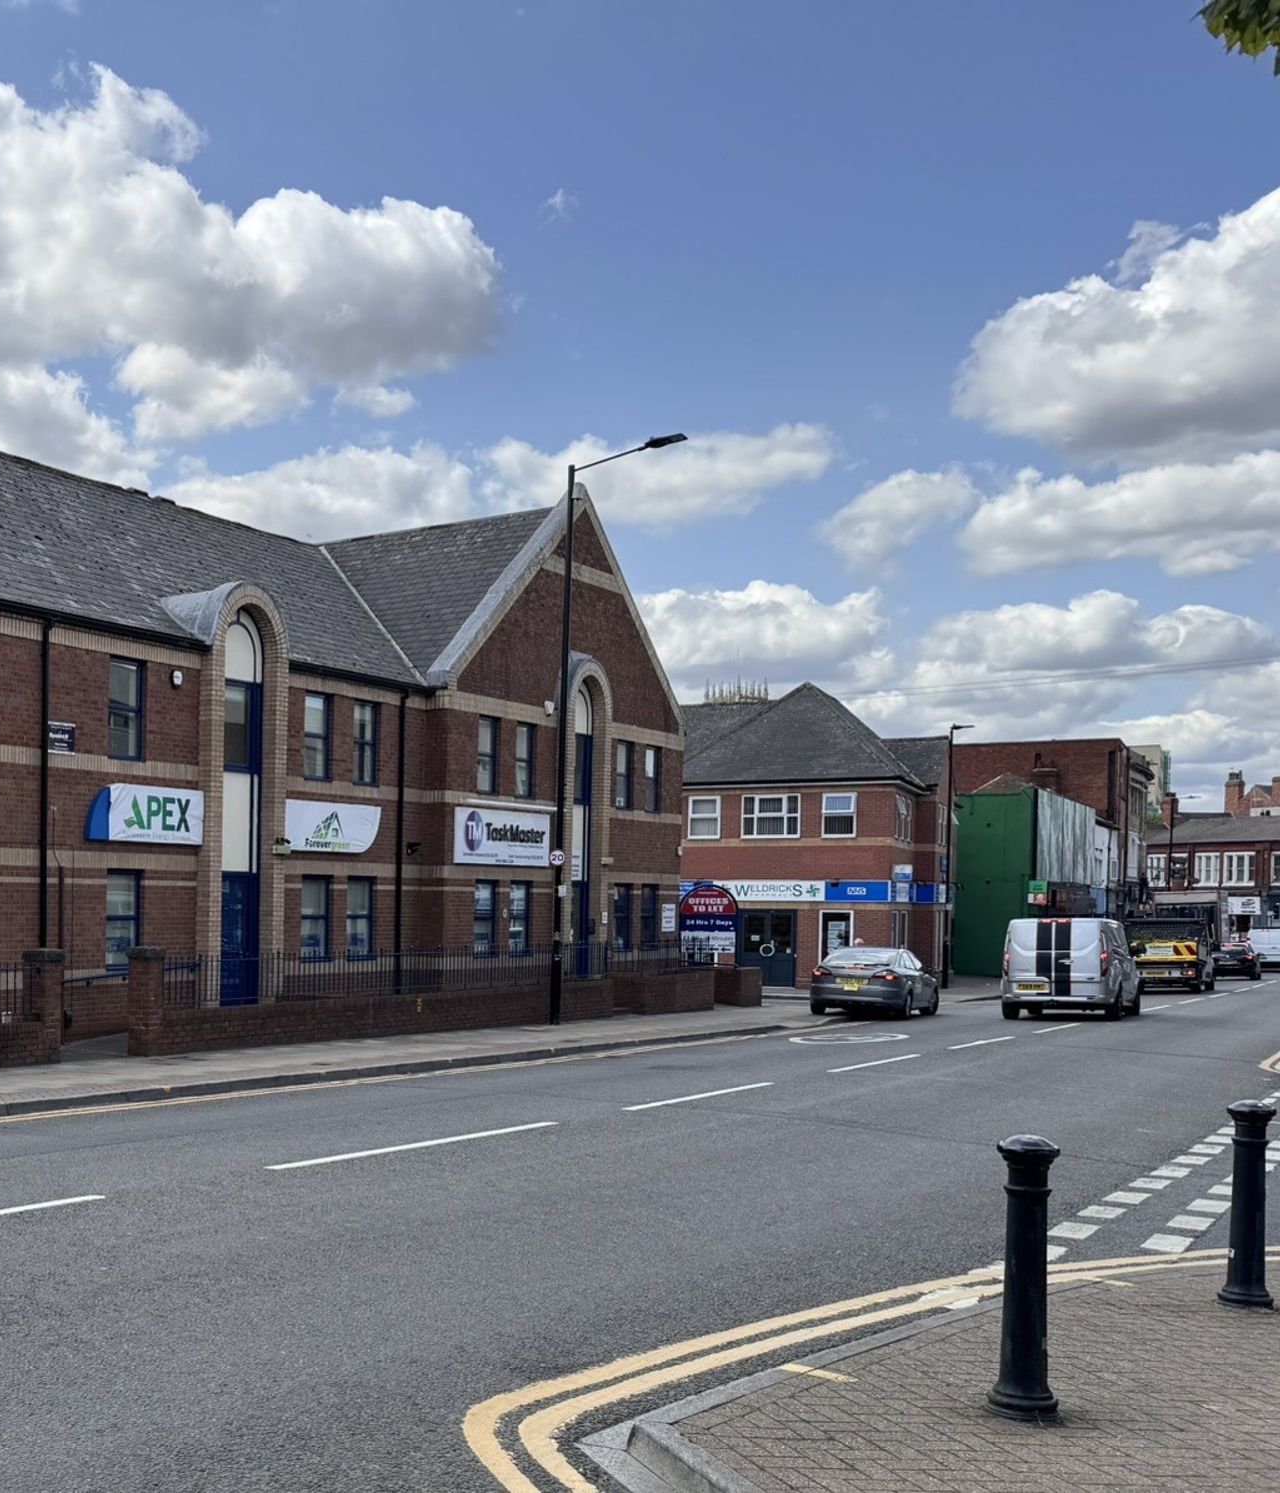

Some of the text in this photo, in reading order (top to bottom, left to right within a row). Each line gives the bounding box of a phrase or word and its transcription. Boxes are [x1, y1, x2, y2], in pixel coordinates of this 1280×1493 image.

[123, 794, 191, 833] APEX
[466, 821, 483, 840] TM
[485, 822, 546, 844] TaskMaster
[551, 853, 563, 861] 20
[735, 884, 803, 897] WELDRICKS
[847, 887, 867, 895] NHS
[688, 897, 729, 905] OFFICES
[716, 919, 733, 927] Days
